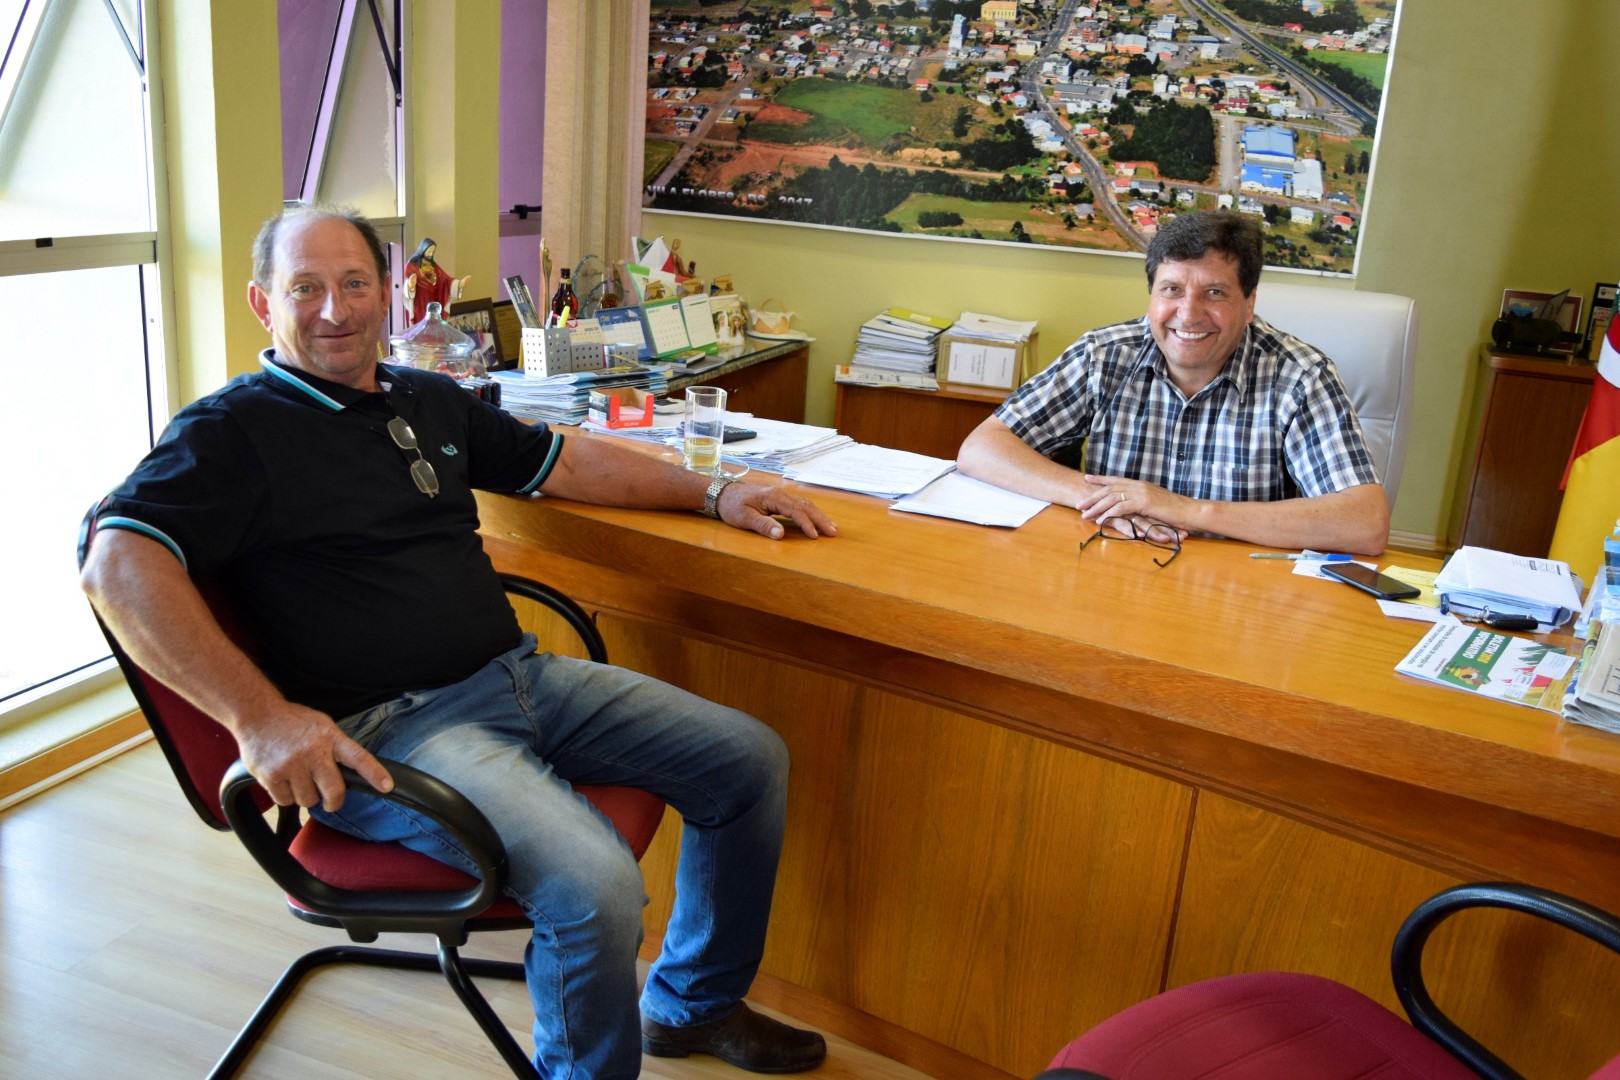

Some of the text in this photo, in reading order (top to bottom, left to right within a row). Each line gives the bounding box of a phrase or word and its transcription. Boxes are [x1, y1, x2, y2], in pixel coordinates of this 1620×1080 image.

[647, 185, 813, 206] VILA FLORES RS 2017
